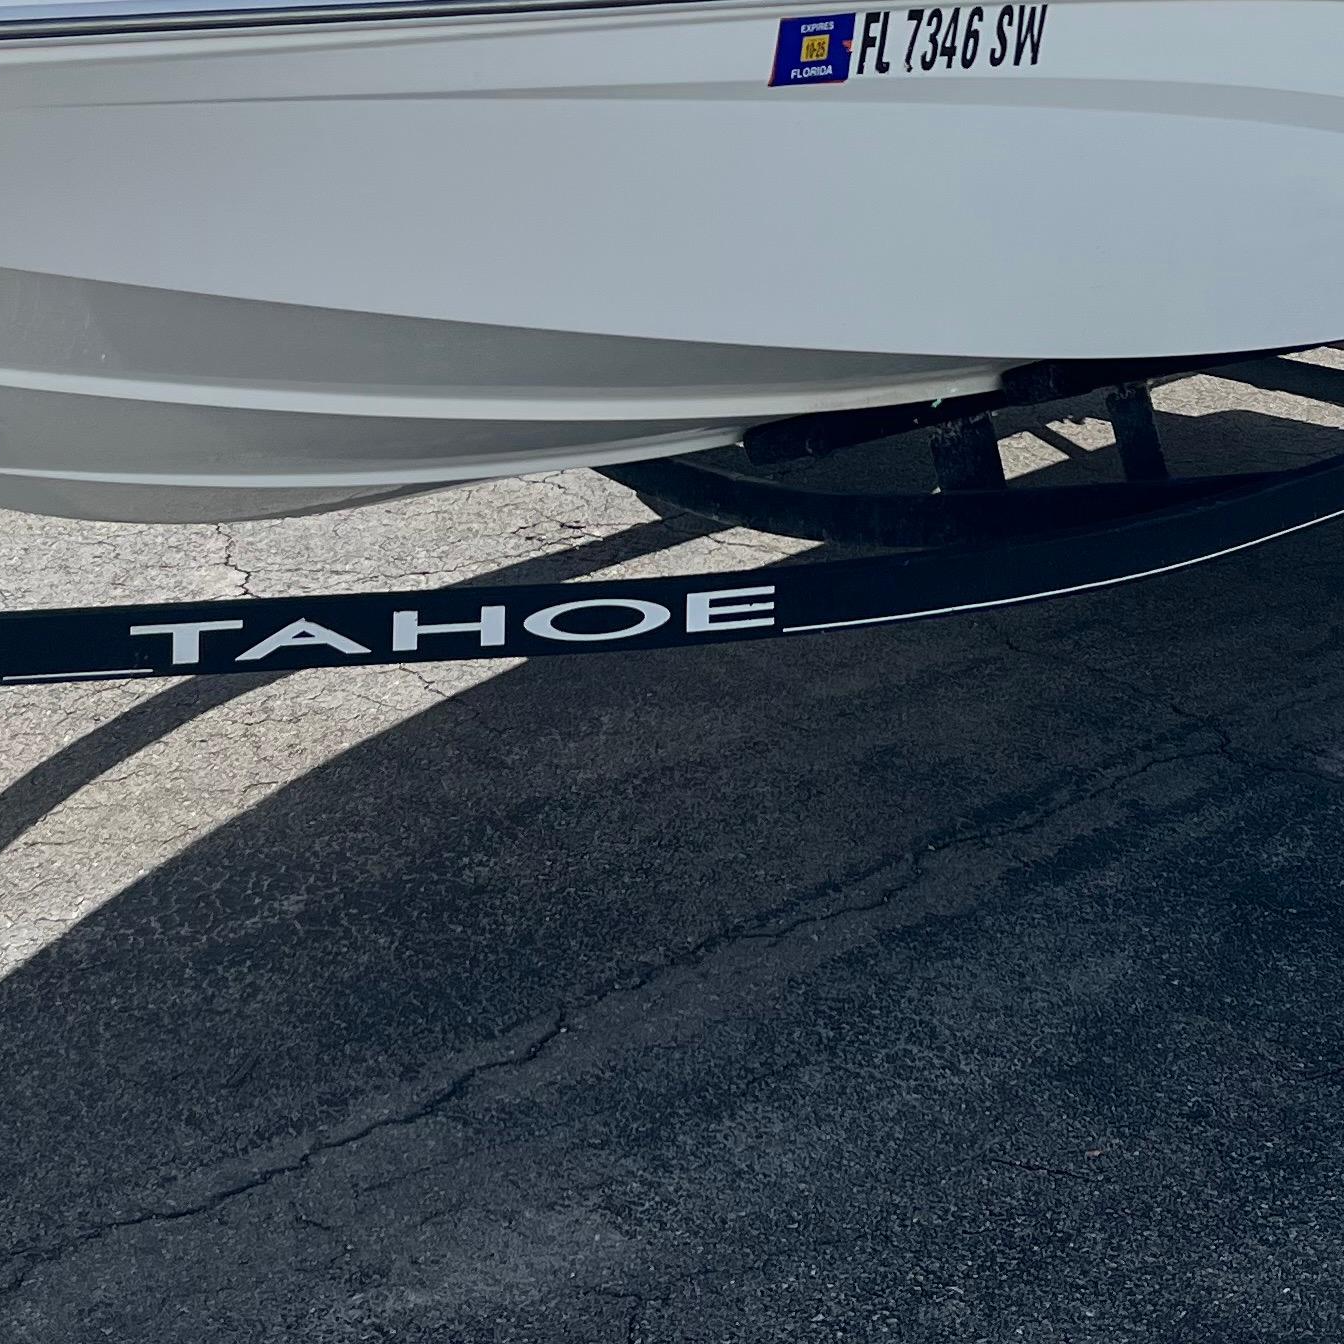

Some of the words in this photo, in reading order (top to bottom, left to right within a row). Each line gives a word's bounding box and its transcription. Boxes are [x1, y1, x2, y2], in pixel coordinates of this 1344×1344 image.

[800, 21, 835, 34] EXPIRES
[856, 11, 891, 75] FL
[903, 5, 985, 73] 7346
[989, 2, 1049, 67] SW
[790, 64, 833, 80] FLORIDA
[129, 585, 776, 666] TAHOE
